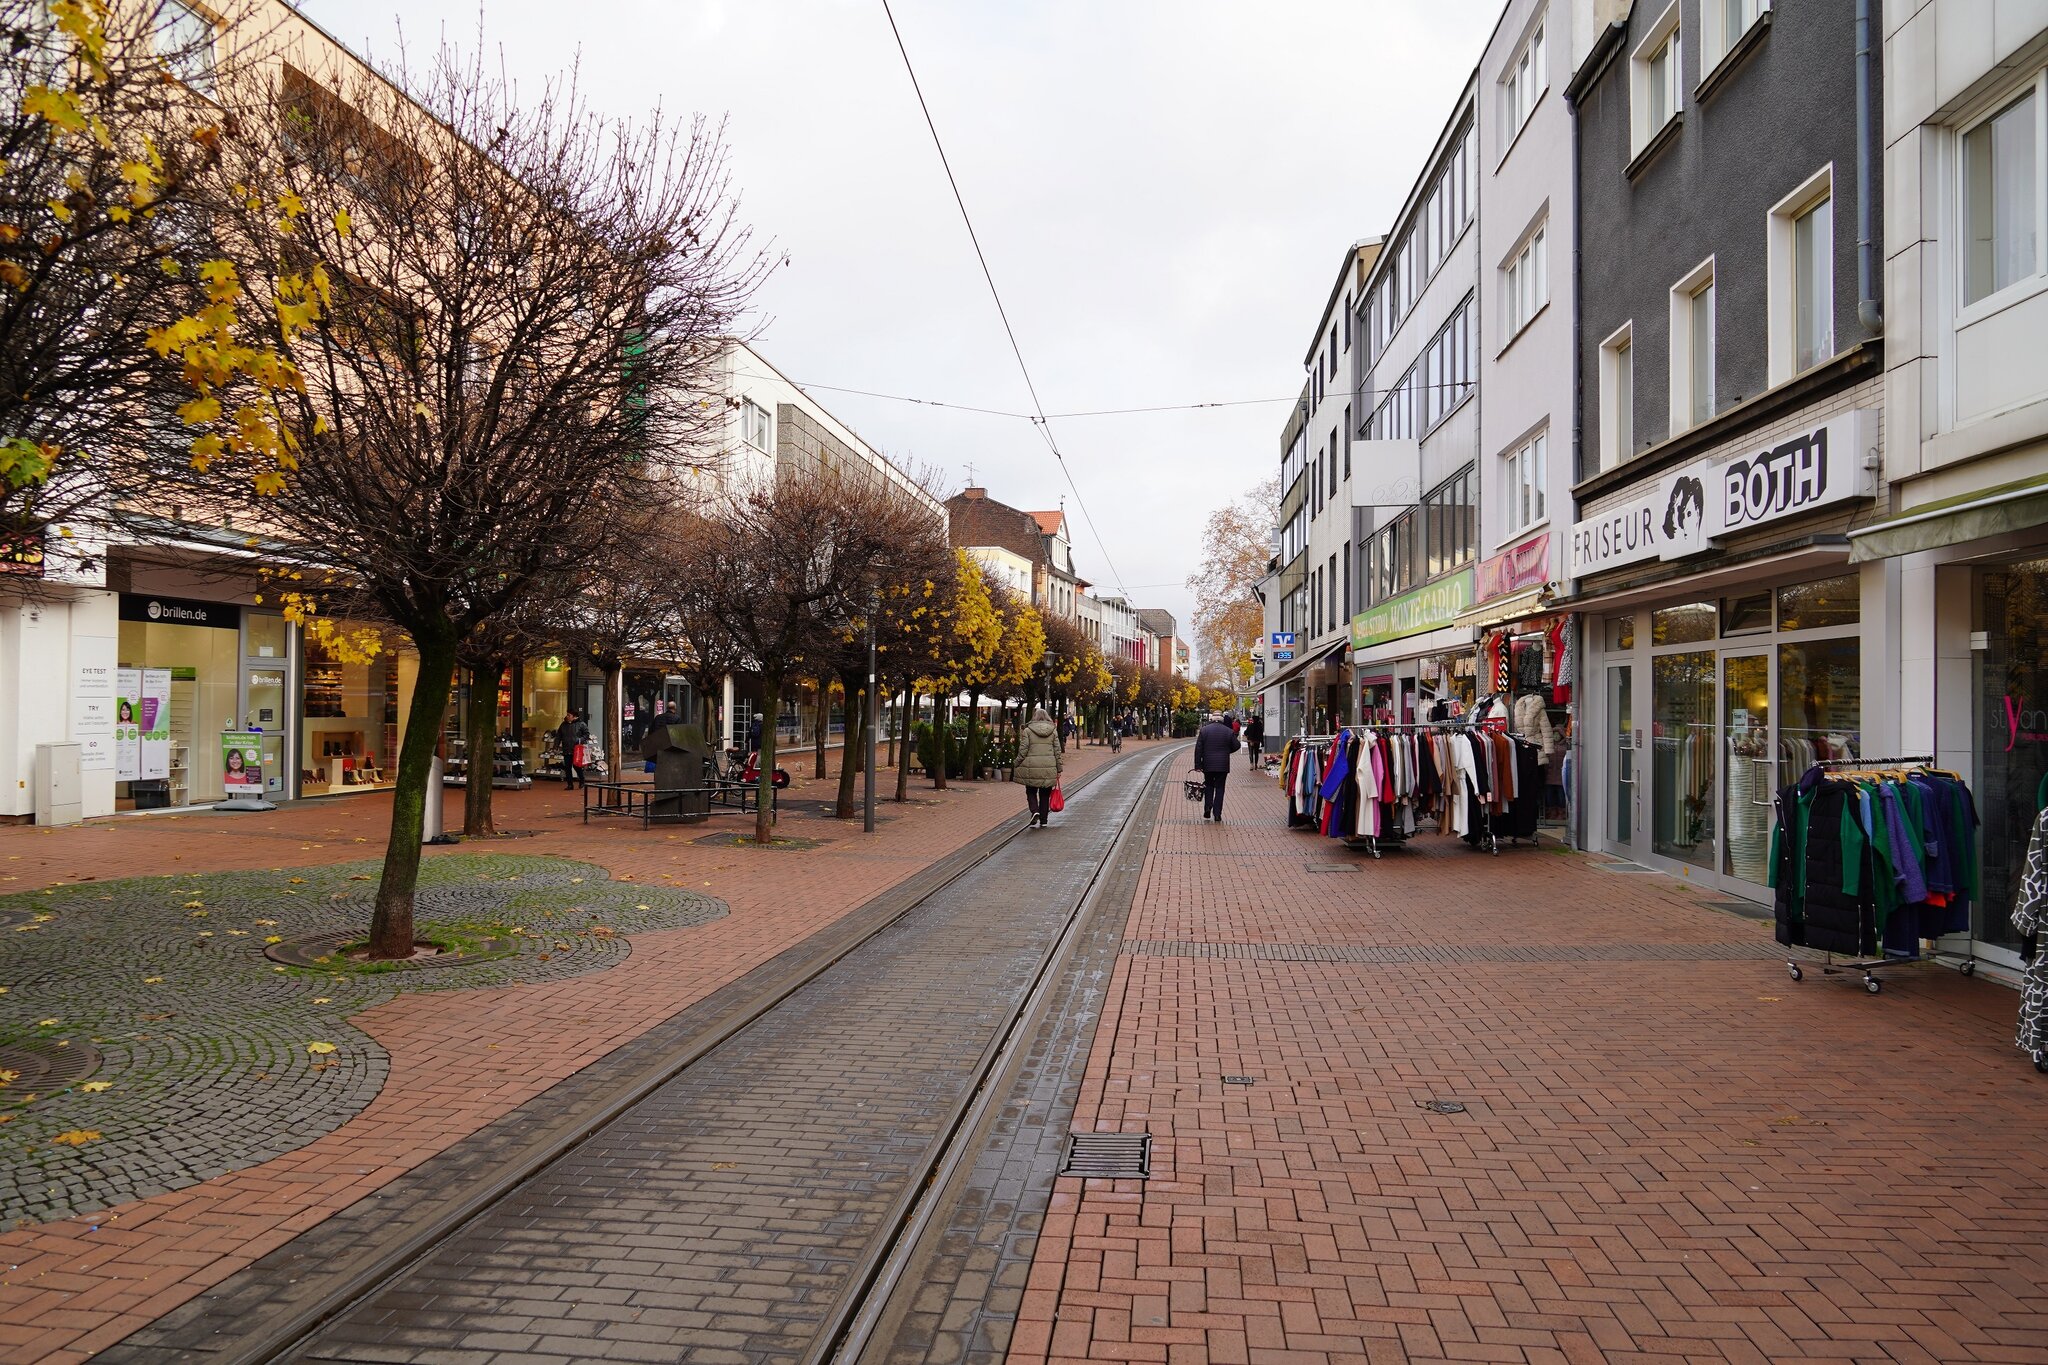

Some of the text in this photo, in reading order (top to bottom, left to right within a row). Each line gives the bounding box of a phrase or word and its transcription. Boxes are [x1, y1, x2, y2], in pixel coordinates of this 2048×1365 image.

[1725, 427, 1828, 528] BOTH
[1573, 507, 1654, 567] FRISEUR
[163, 606, 207, 621] brillen.de
[1389, 597, 1421, 634] MONTE
[1423, 580, 1462, 624] CARLO
[258, 676, 282, 684] brillen.de
